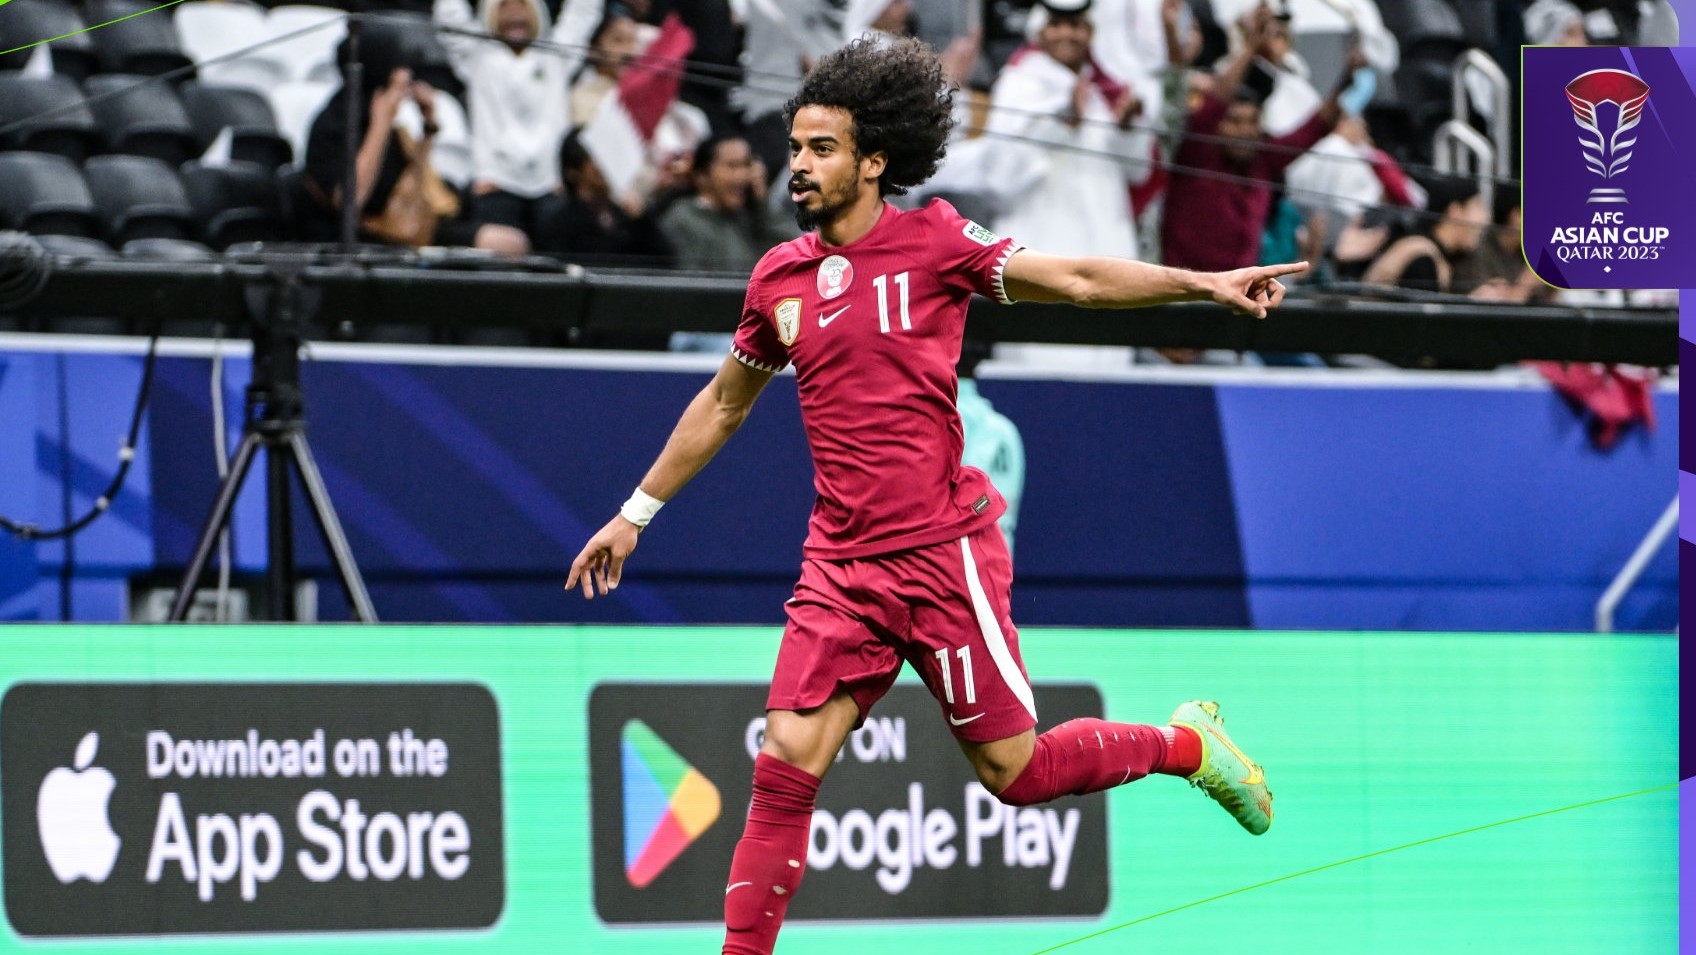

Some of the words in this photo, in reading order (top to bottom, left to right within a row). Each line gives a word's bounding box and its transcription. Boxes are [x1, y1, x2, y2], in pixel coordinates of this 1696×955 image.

[872, 271, 912, 334] 11
[935, 644, 977, 704] 11
[146, 728, 326, 778] Download
[333, 738, 380, 778] on
[387, 728, 449, 778] the
[851, 716, 907, 763] ON
[144, 792, 285, 902] App
[296, 789, 472, 882] Store
[806, 781, 958, 895] oogle
[964, 781, 1081, 891] Play
